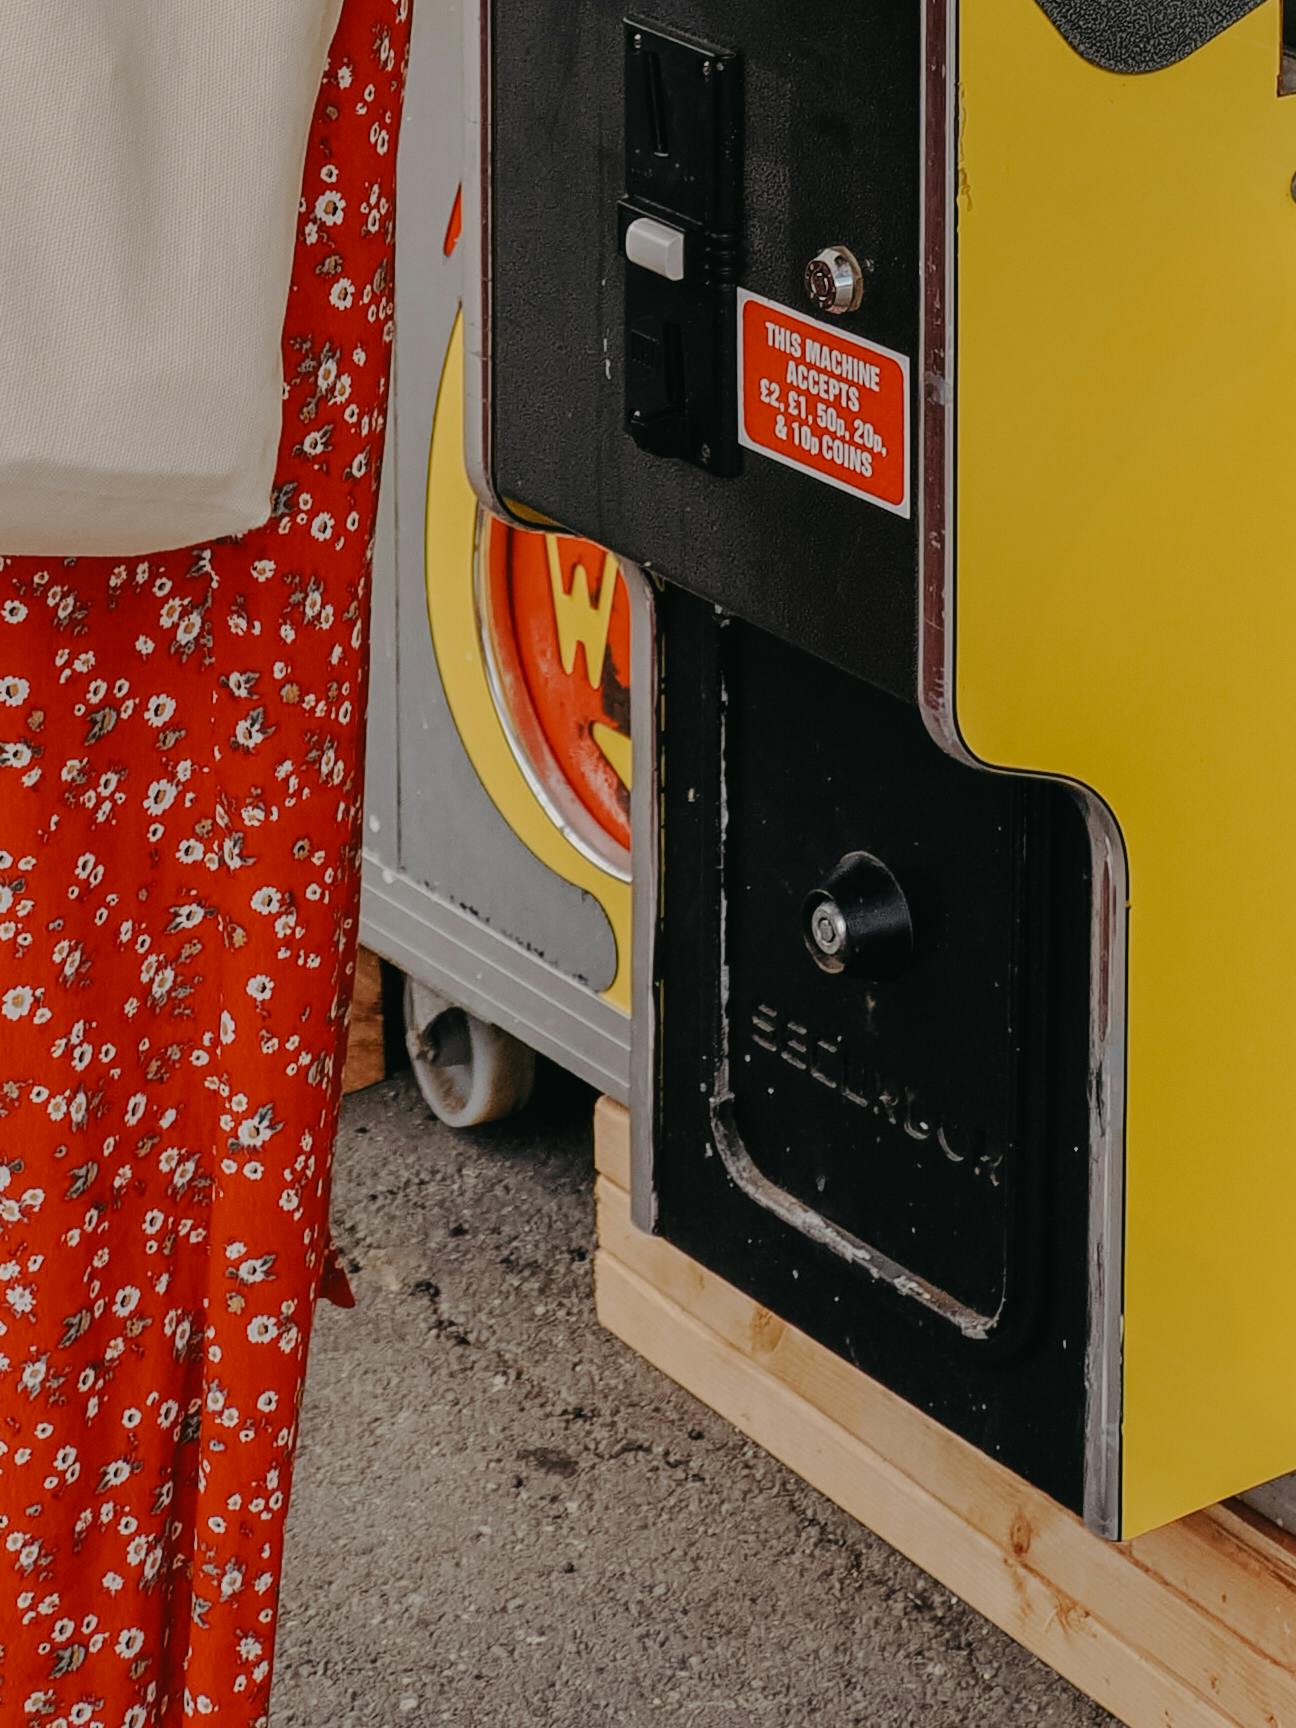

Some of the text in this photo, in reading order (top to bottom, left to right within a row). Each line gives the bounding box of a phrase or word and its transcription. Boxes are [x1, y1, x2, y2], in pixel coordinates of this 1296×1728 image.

[765, 321, 880, 392] THIS MACHINE
[786, 360, 860, 412] ACCEPTS
[760, 378, 887, 457] £2, £1, 50p, 20p,
[775, 414, 873, 478] & 10p COINS
